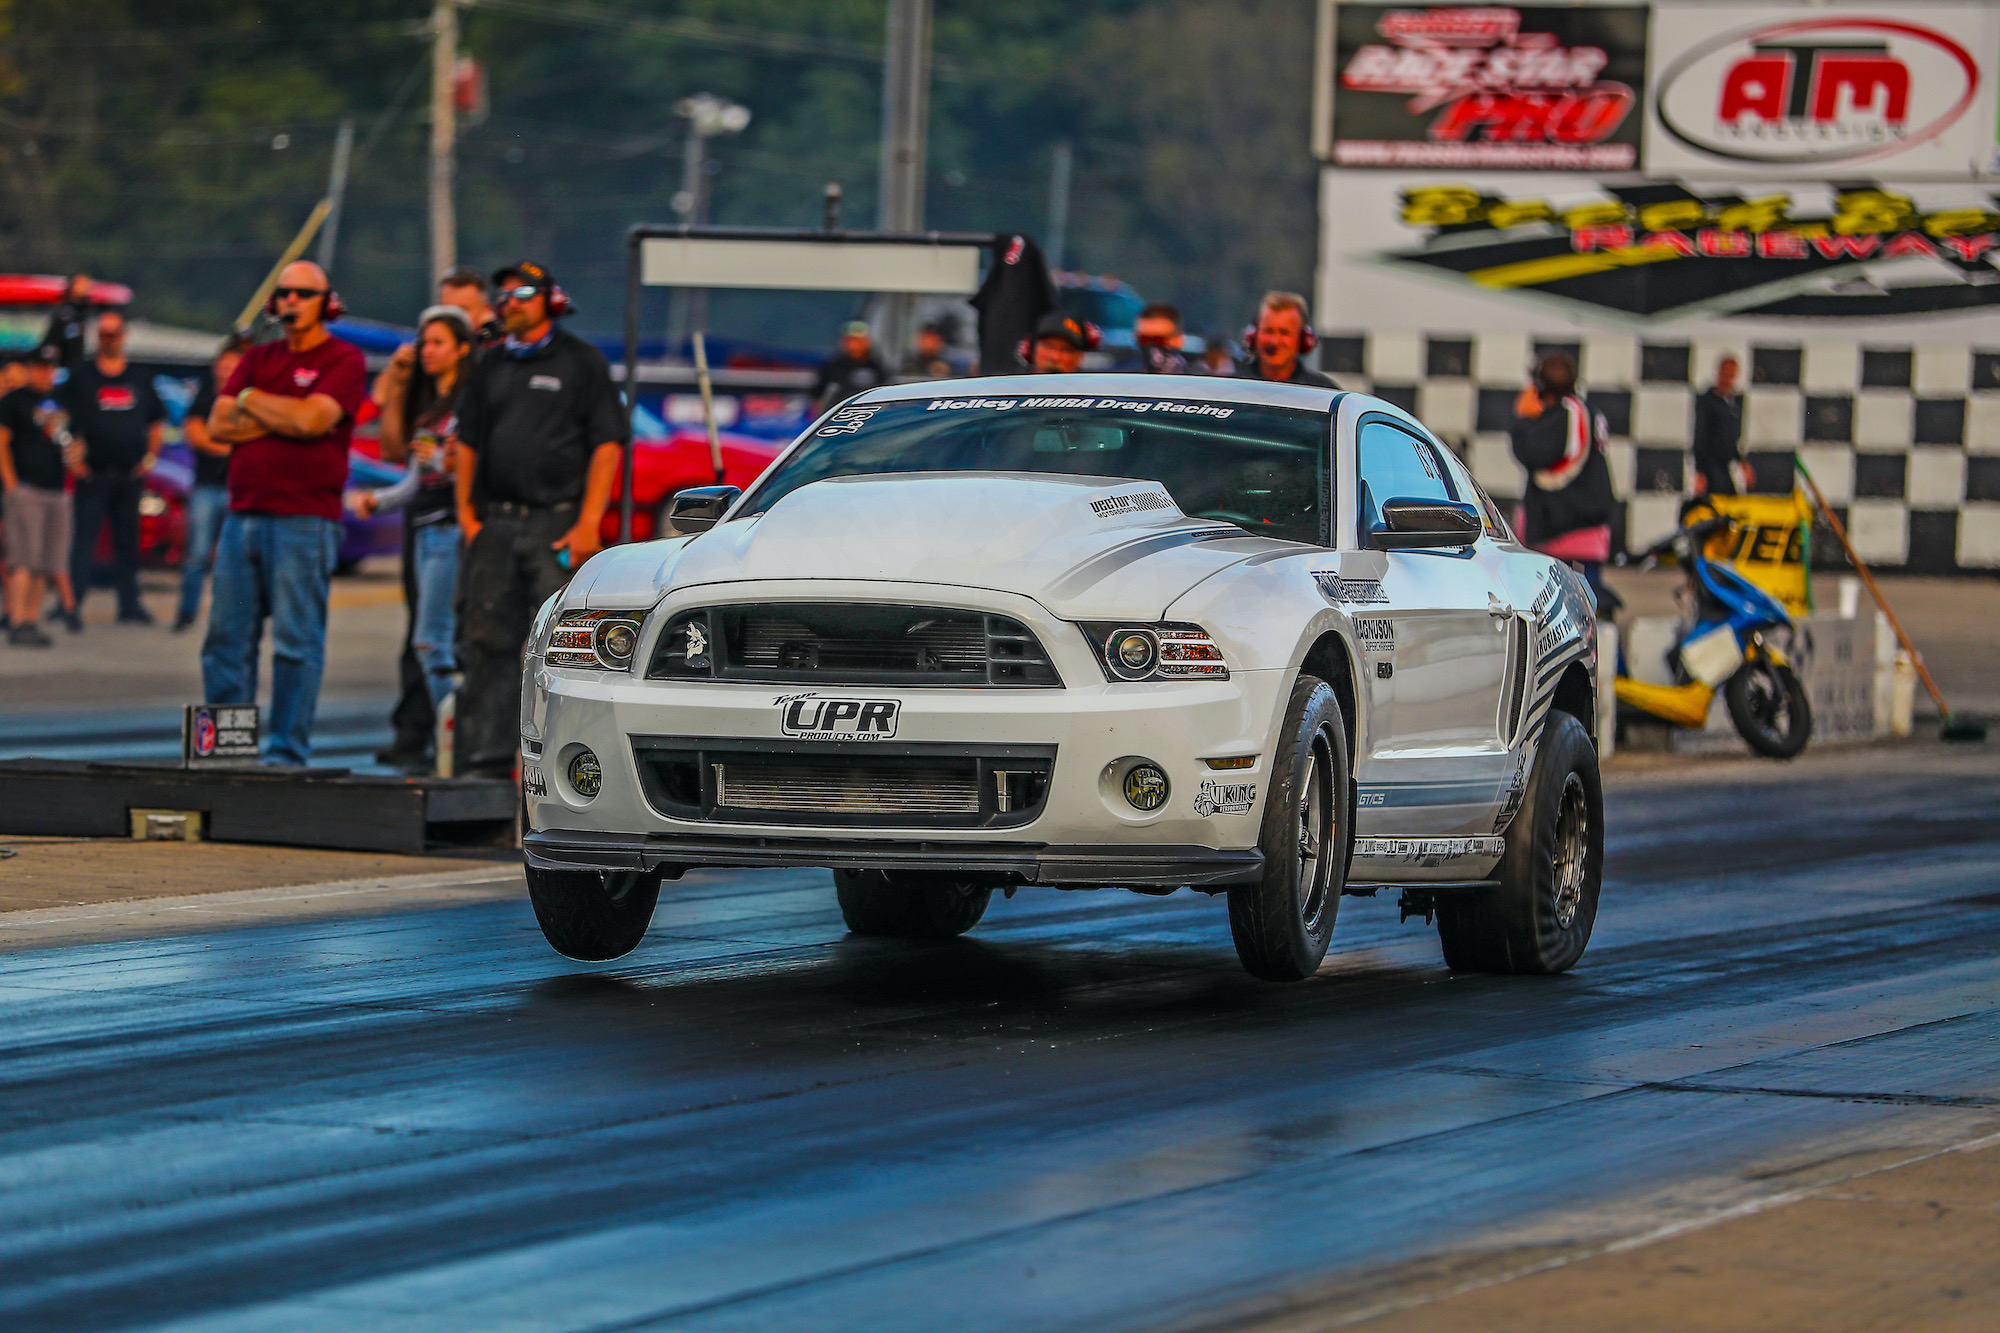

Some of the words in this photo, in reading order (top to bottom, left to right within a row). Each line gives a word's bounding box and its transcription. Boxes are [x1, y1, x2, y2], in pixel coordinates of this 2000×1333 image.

[1715, 38, 1913, 126] ATM
[1570, 222, 1998, 262] RACEWAY
[926, 399, 1017, 411] Holley
[1019, 398, 1096, 409] NMRA
[1096, 399, 1152, 412] Drag
[1152, 402, 1235, 419] Racing
[1089, 495, 1130, 513] vector
[1352, 617, 1394, 640] MAGNUSON
[772, 692, 819, 706] Team
[785, 700, 896, 731] UPR
[799, 732, 881, 741] PRODUCTS.COM
[1209, 784, 1257, 804] VIKING
